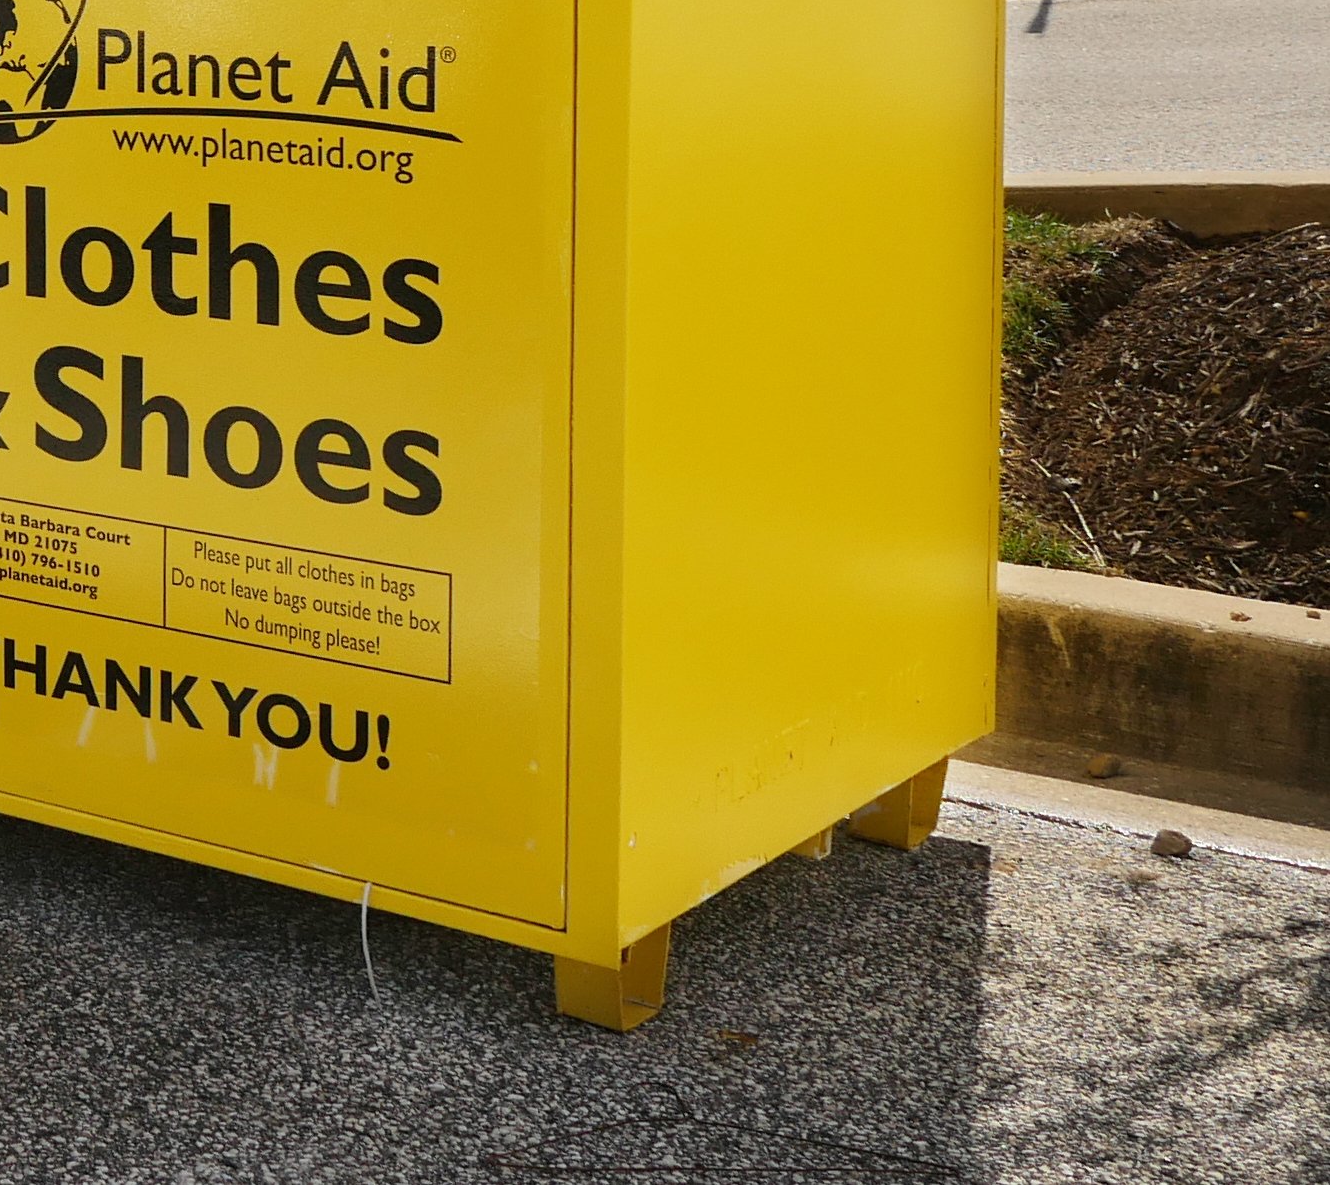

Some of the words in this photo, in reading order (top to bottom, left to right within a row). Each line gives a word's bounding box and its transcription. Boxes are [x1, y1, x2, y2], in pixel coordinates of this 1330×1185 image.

[98, 29, 292, 103] Planet
[113, 128, 413, 184] www.planetaid.org
[34, 346, 442, 516] Shoes
[4, 529, 29, 545] MD
[35, 535, 77, 554] 21075
[21, 514, 80, 537] Barbara
[85, 526, 130, 546] Court
[31, 553, 100, 577] 796-1510
[194, 541, 240, 566] Please
[246, 556, 271, 574] put
[276, 556, 292, 575] all
[298, 560, 354, 586] clothes
[361, 571, 374, 590] in
[381, 573, 415, 602] bags
[172, 567, 195, 588] Do
[200, 578, 226, 595] not
[231, 578, 268, 602] leave
[274, 586, 306, 614] bags
[313, 599, 371, 621] outside
[377, 605, 403, 627] the
[409, 610, 440, 634] box
[225, 608, 249, 630] No
[255, 614, 321, 649] dumping
[326, 628, 380, 655] please!
[211, 680, 394, 772] YOU!
